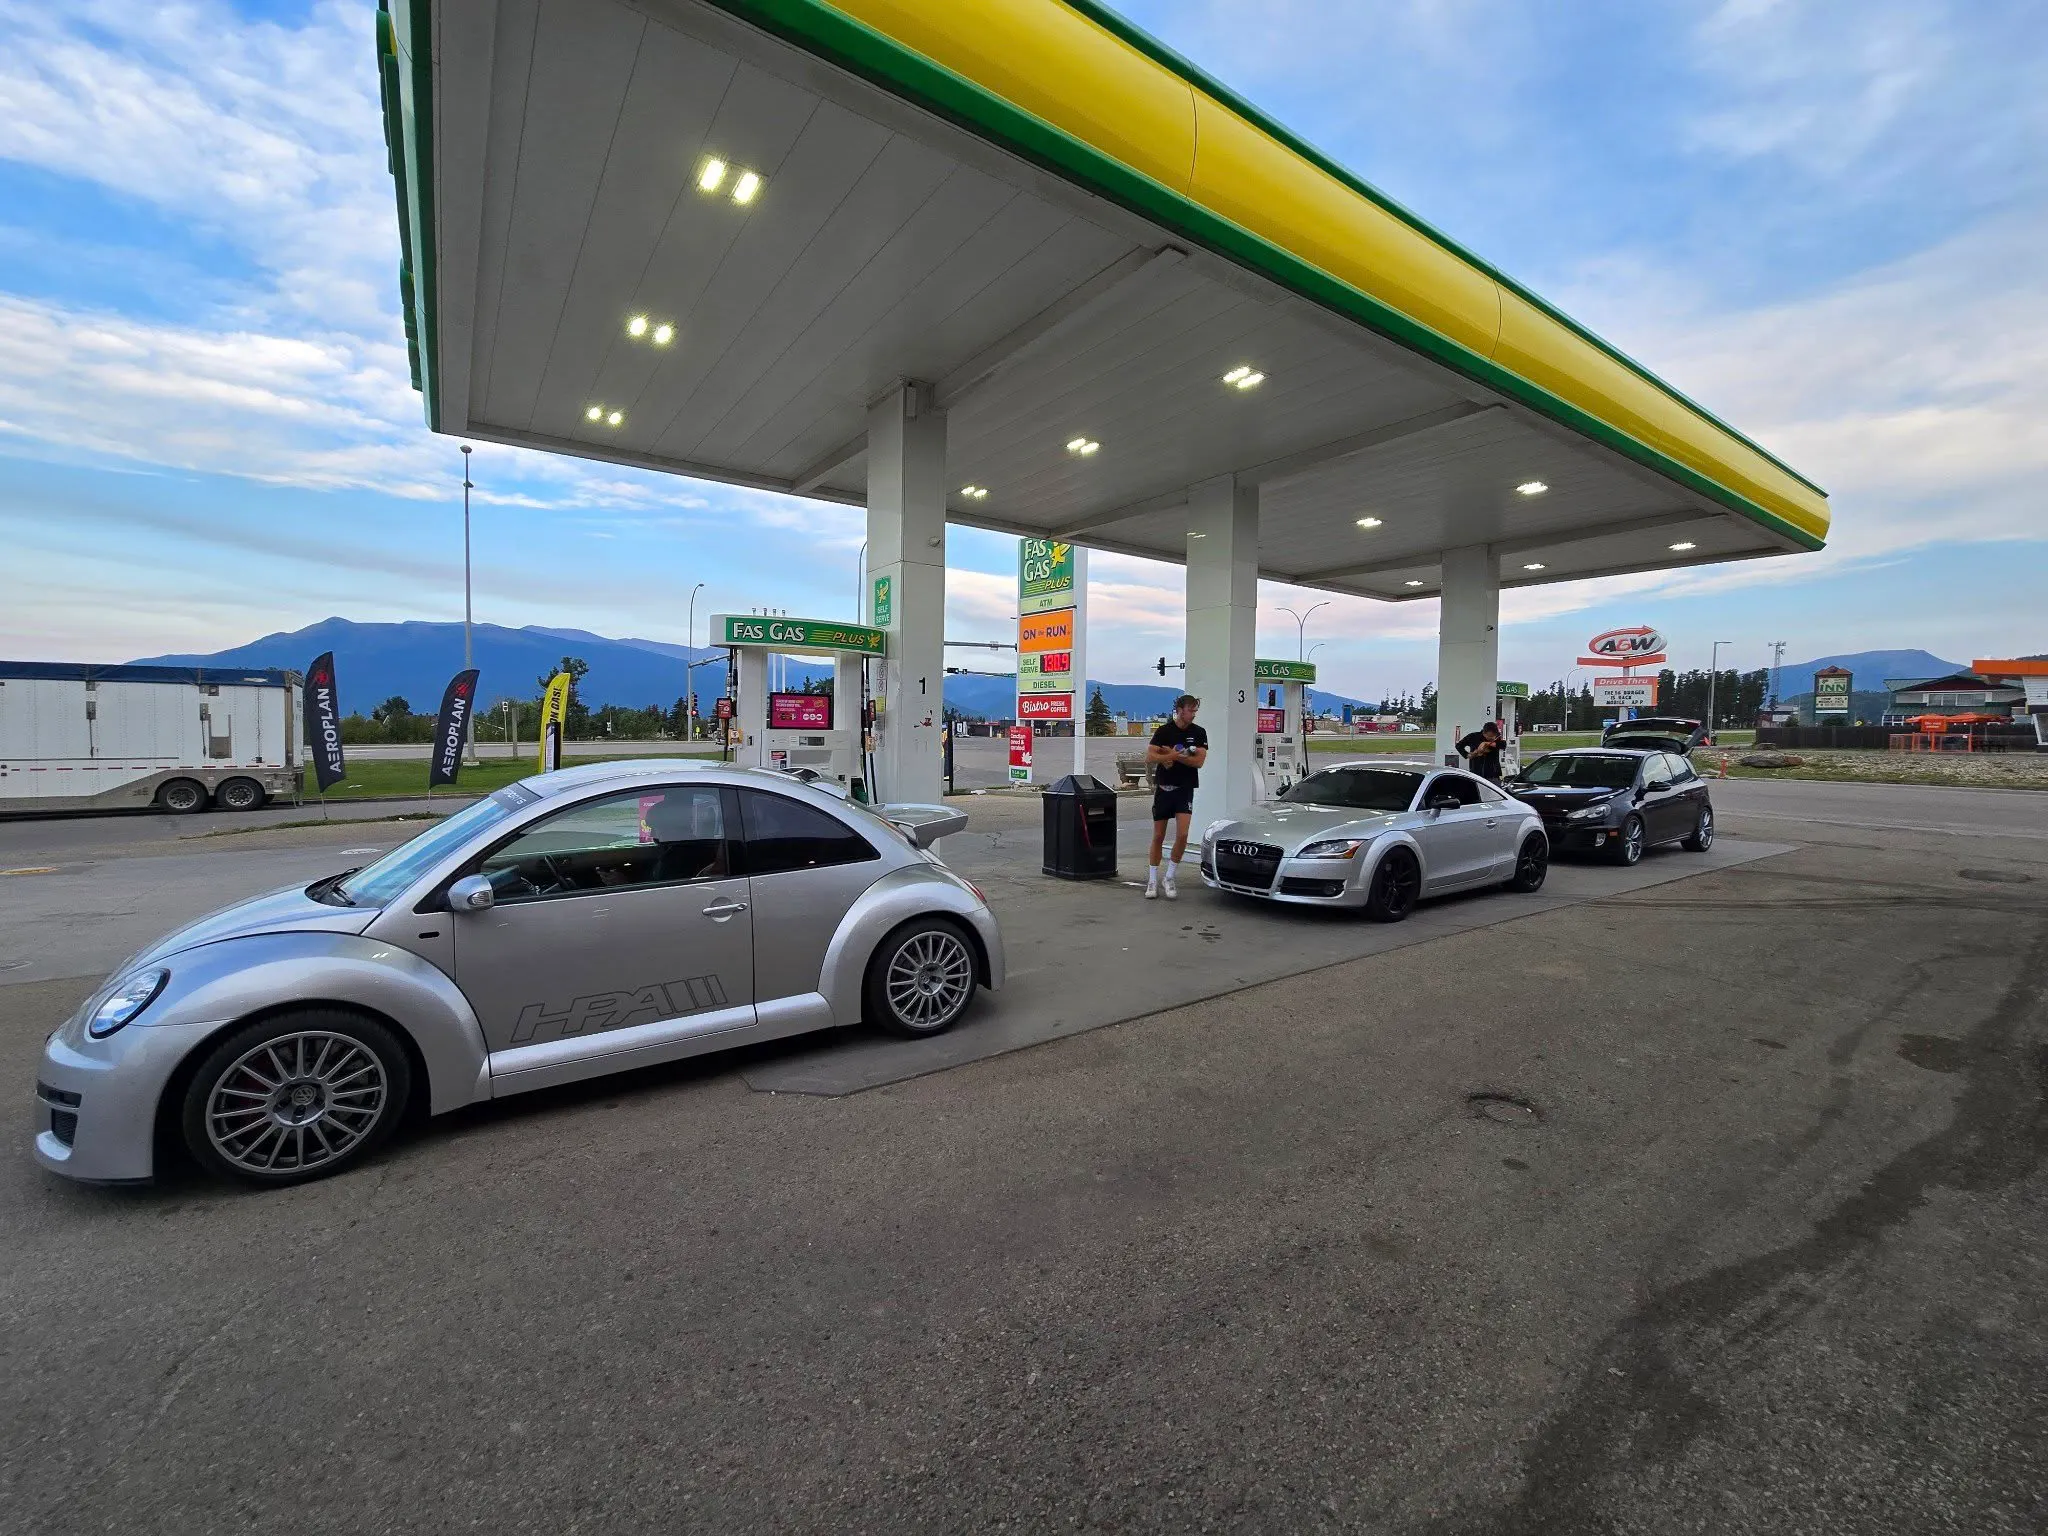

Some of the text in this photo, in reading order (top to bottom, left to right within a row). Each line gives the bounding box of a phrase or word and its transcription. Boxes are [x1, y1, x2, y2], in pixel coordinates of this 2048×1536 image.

[1025, 540, 1047, 560] FAS
[1024, 560, 1050, 582] GAS
[1044, 576, 1071, 590] PLUS
[877, 605, 888, 614] SELF
[1039, 599, 1053, 608] ATM
[876, 614, 890, 624] SERVE
[733, 622, 865, 645] FAS GAS PLUS
[1023, 629, 1036, 640] ON
[1046, 625, 1066, 638] RUN
[1599, 636, 1658, 653] A&W
[1044, 654, 1069, 672] 130.9
[1272, 664, 1290, 676] GAS
[918, 677, 926, 694] 1
[1032, 680, 1056, 688] DIESEL
[1506, 684, 1518, 694] GAS
[1238, 690, 1245, 703] 3
[1022, 700, 1050, 713] Bistro
[1486, 706, 1490, 716] 5
[318, 688, 342, 772] AEROPLAN
[442, 698, 466, 776] AEROPLAN
